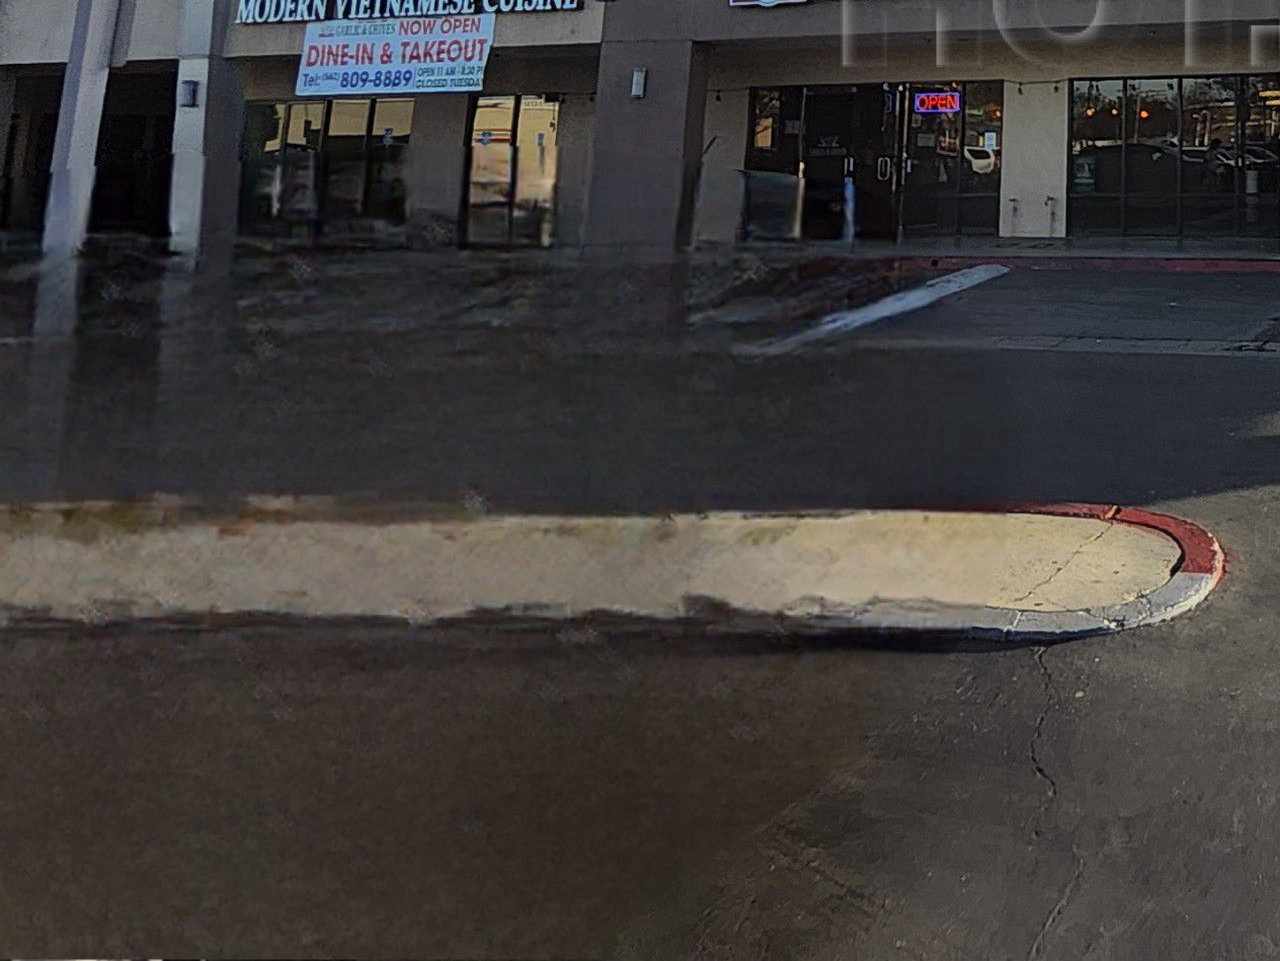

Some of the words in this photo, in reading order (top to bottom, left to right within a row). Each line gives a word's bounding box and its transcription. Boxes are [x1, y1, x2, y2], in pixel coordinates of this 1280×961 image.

[399, 20, 436, 36] NOW
[440, 17, 482, 35] OPEN
[306, 42, 375, 67] DINE-IN
[380, 41, 393, 65] &
[401, 38, 488, 64] TAKEOUT
[417, 67, 435, 77] OPEN
[445, 66, 457, 76] AM
[416, 78, 447, 88] CLOSED
[917, 94, 958, 111] OPEN
